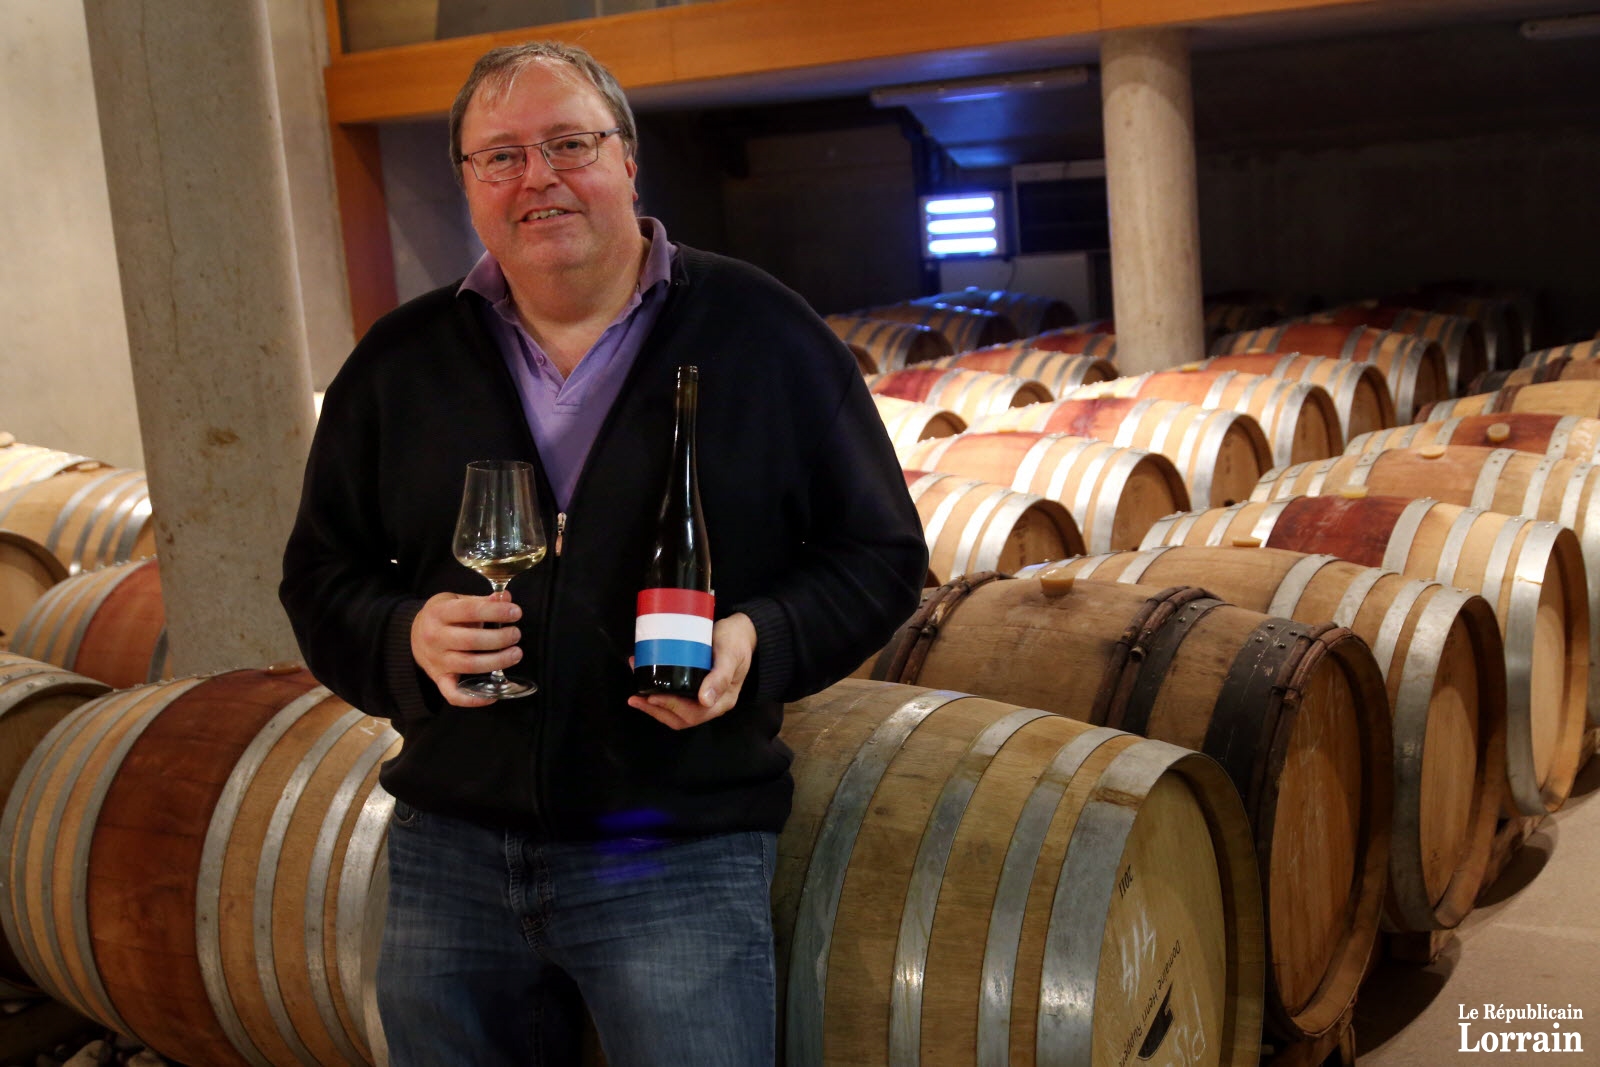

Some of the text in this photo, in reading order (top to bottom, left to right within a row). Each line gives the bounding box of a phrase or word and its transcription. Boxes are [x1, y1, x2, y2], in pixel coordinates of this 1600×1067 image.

[1118, 864, 1133, 899] 2011
[1157, 939, 1181, 990] Domaine
[1140, 989, 1159, 1026] Henri
